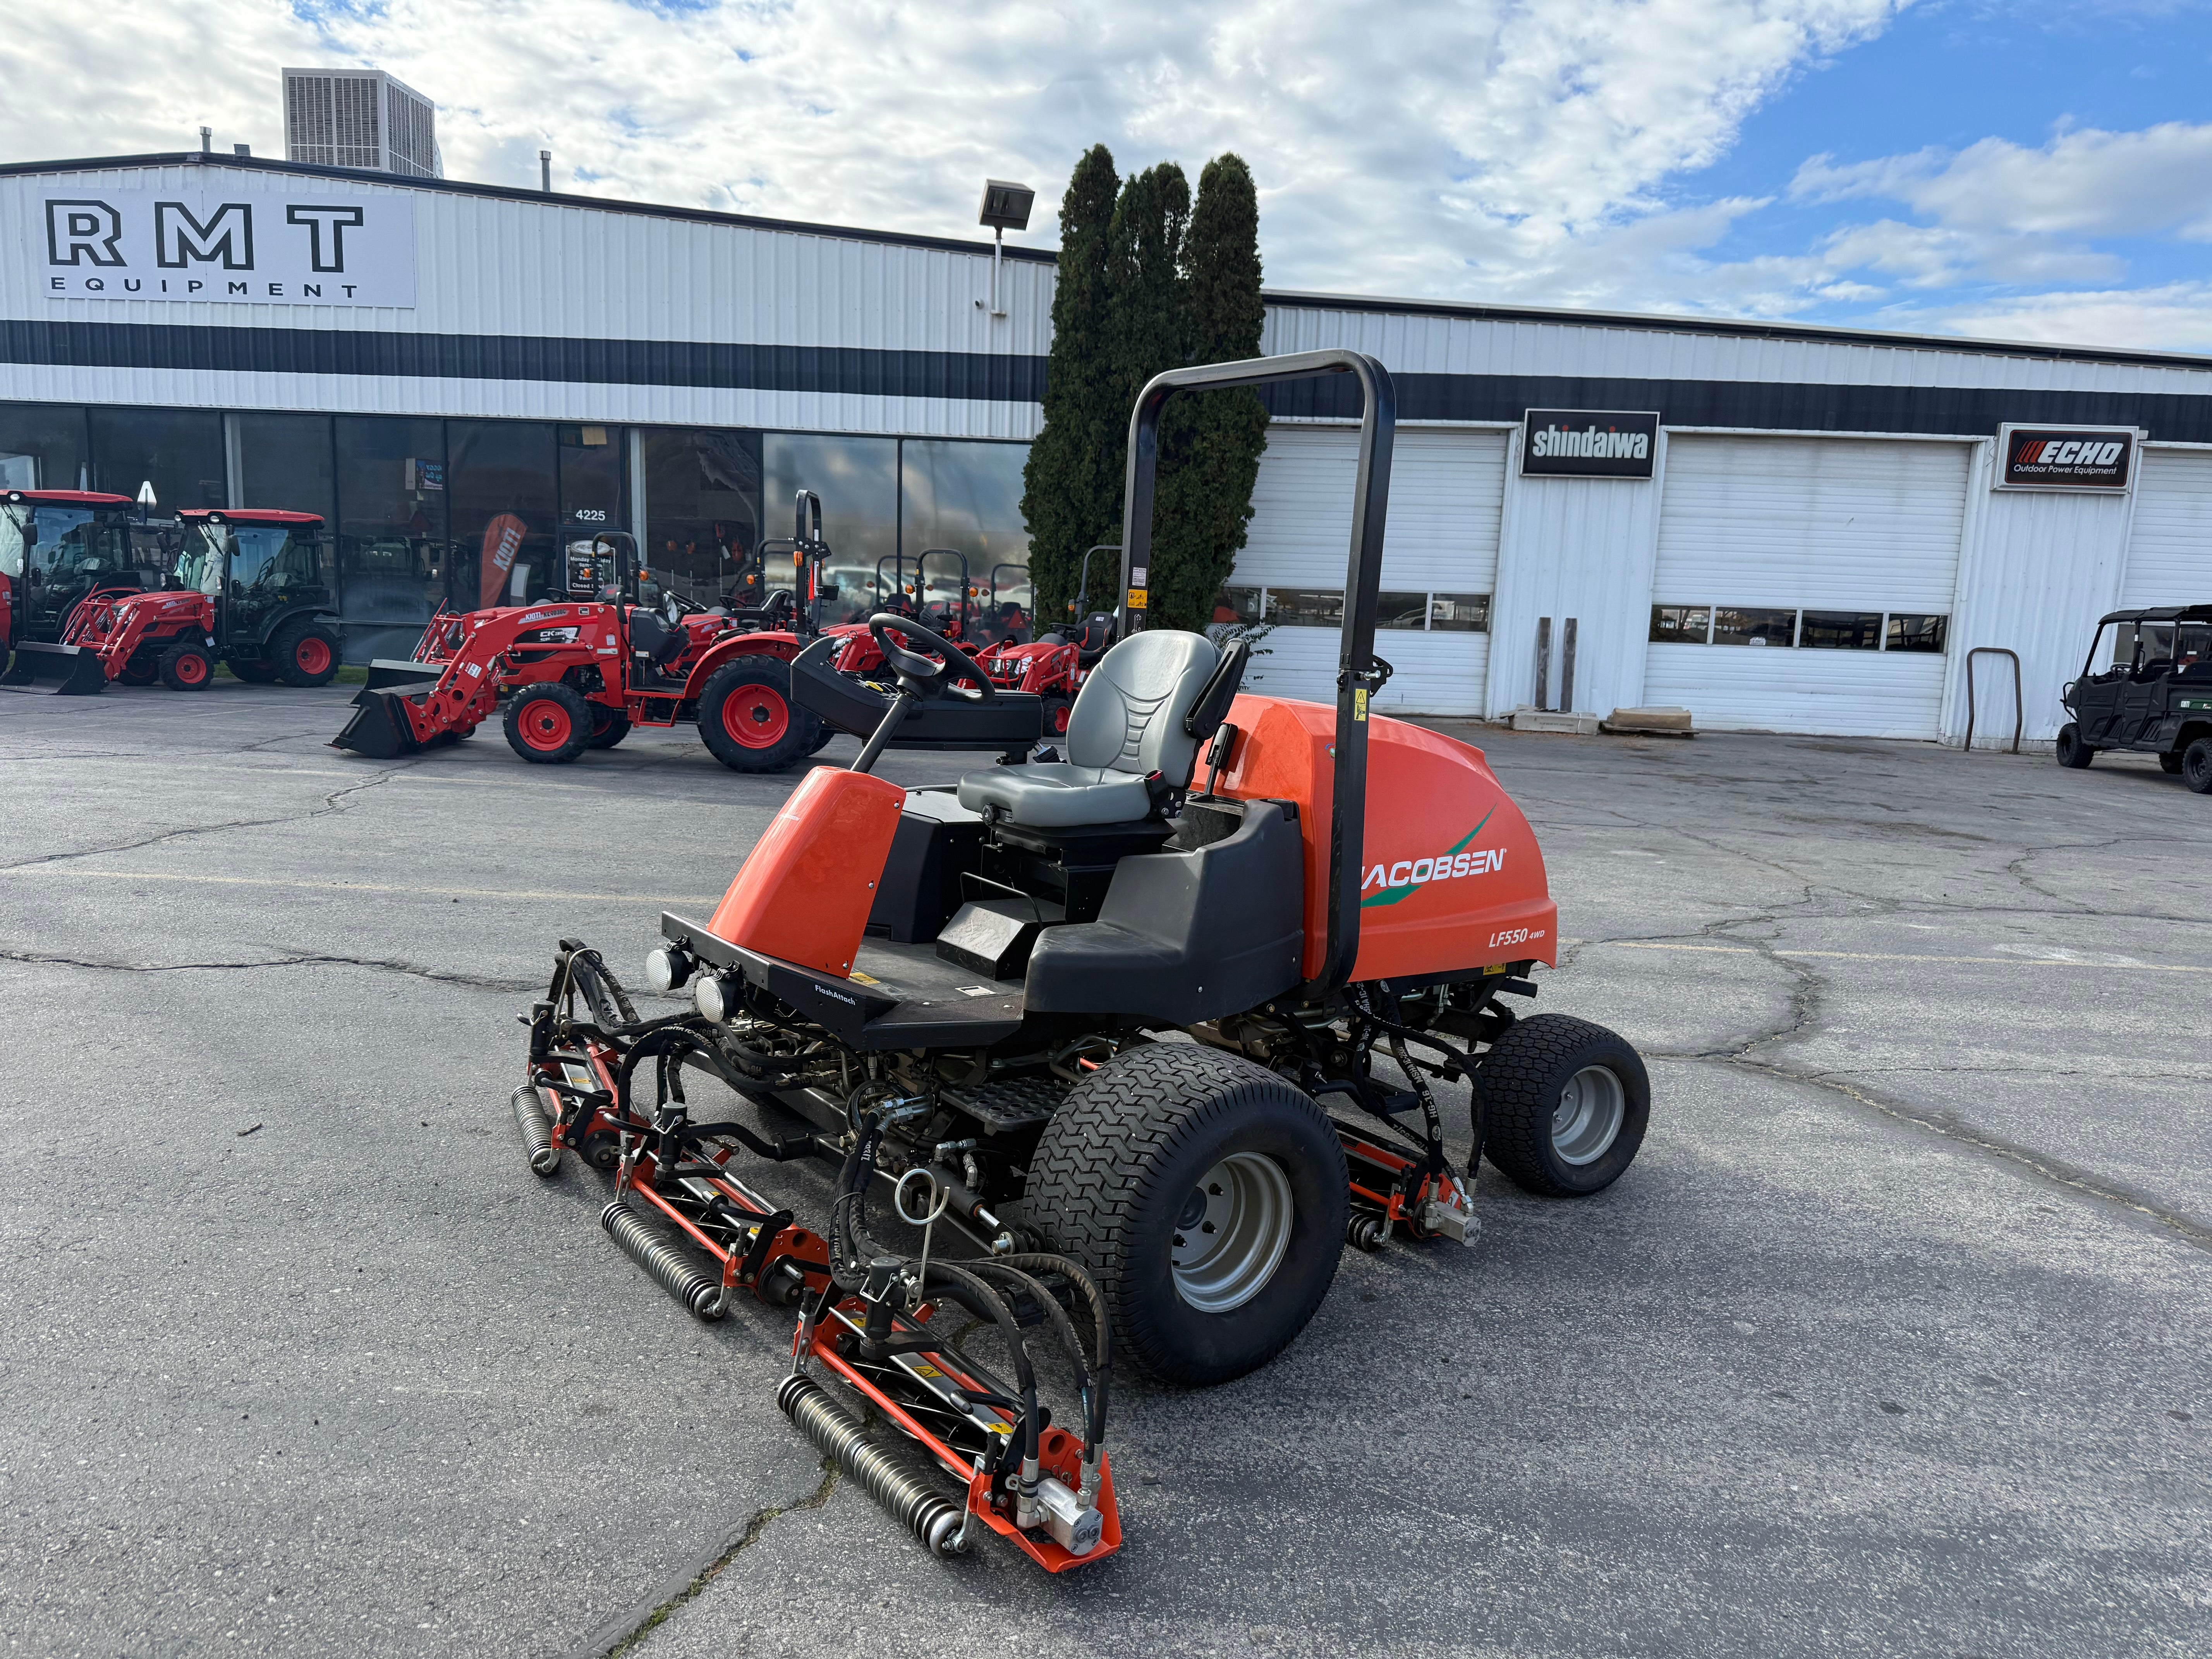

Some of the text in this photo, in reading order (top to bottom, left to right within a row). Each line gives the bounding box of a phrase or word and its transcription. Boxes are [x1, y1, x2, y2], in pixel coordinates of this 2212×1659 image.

[45, 199, 363, 273] RMT
[50, 276, 358, 299] EQUIPMENT
[1532, 424, 1649, 459] shindaiwa
[2037, 441, 2124, 465] ECHO
[2014, 464, 2117, 476] Outdoor Power Equipment
[575, 509, 606, 521] 4225
[492, 527, 521, 572] KIOTI
[526, 612, 541, 620] KIOTI
[1361, 848, 1505, 890] ACOBSEN
[1488, 928, 1545, 948] LF550 4WD
[815, 984, 855, 1006] FlashAttach
[1407, 1063, 1424, 1084] MSHA
[1422, 1089, 1438, 1118] HG-16
